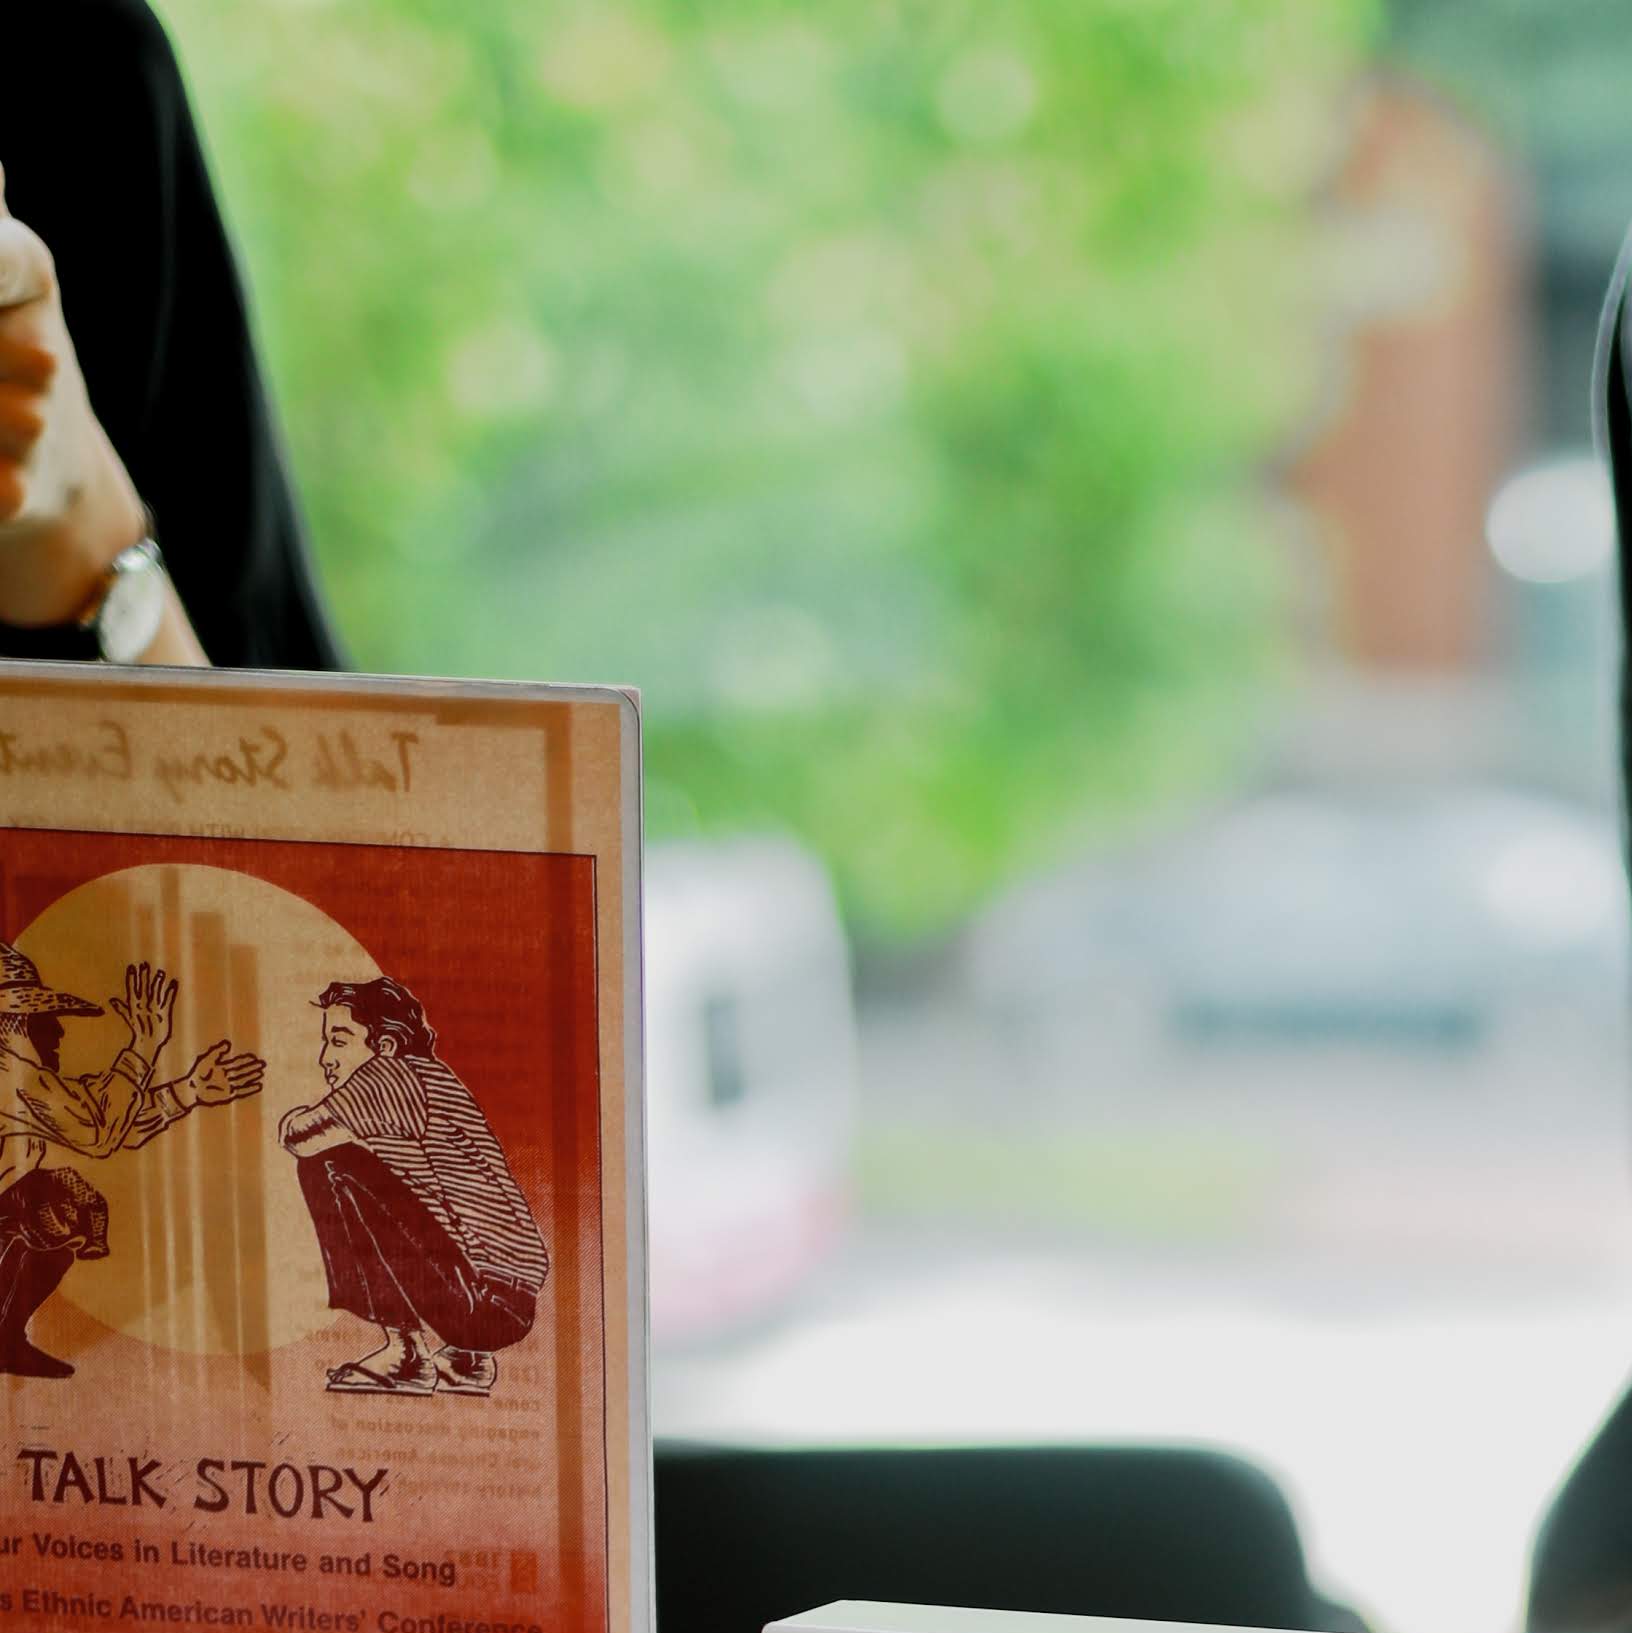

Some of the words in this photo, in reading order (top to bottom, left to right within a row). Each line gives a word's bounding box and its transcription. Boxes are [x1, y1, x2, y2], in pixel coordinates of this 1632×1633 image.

[16, 1448, 168, 1510] TALK
[193, 1457, 390, 1523] STORY
[32, 1532, 125, 1562] Voices
[134, 1538, 161, 1564] in
[171, 1541, 308, 1573] Literature
[319, 1552, 371, 1577] and
[382, 1553, 457, 1588] Song
[23, 1588, 111, 1619] Ethnic
[119, 1595, 254, 1627] American
